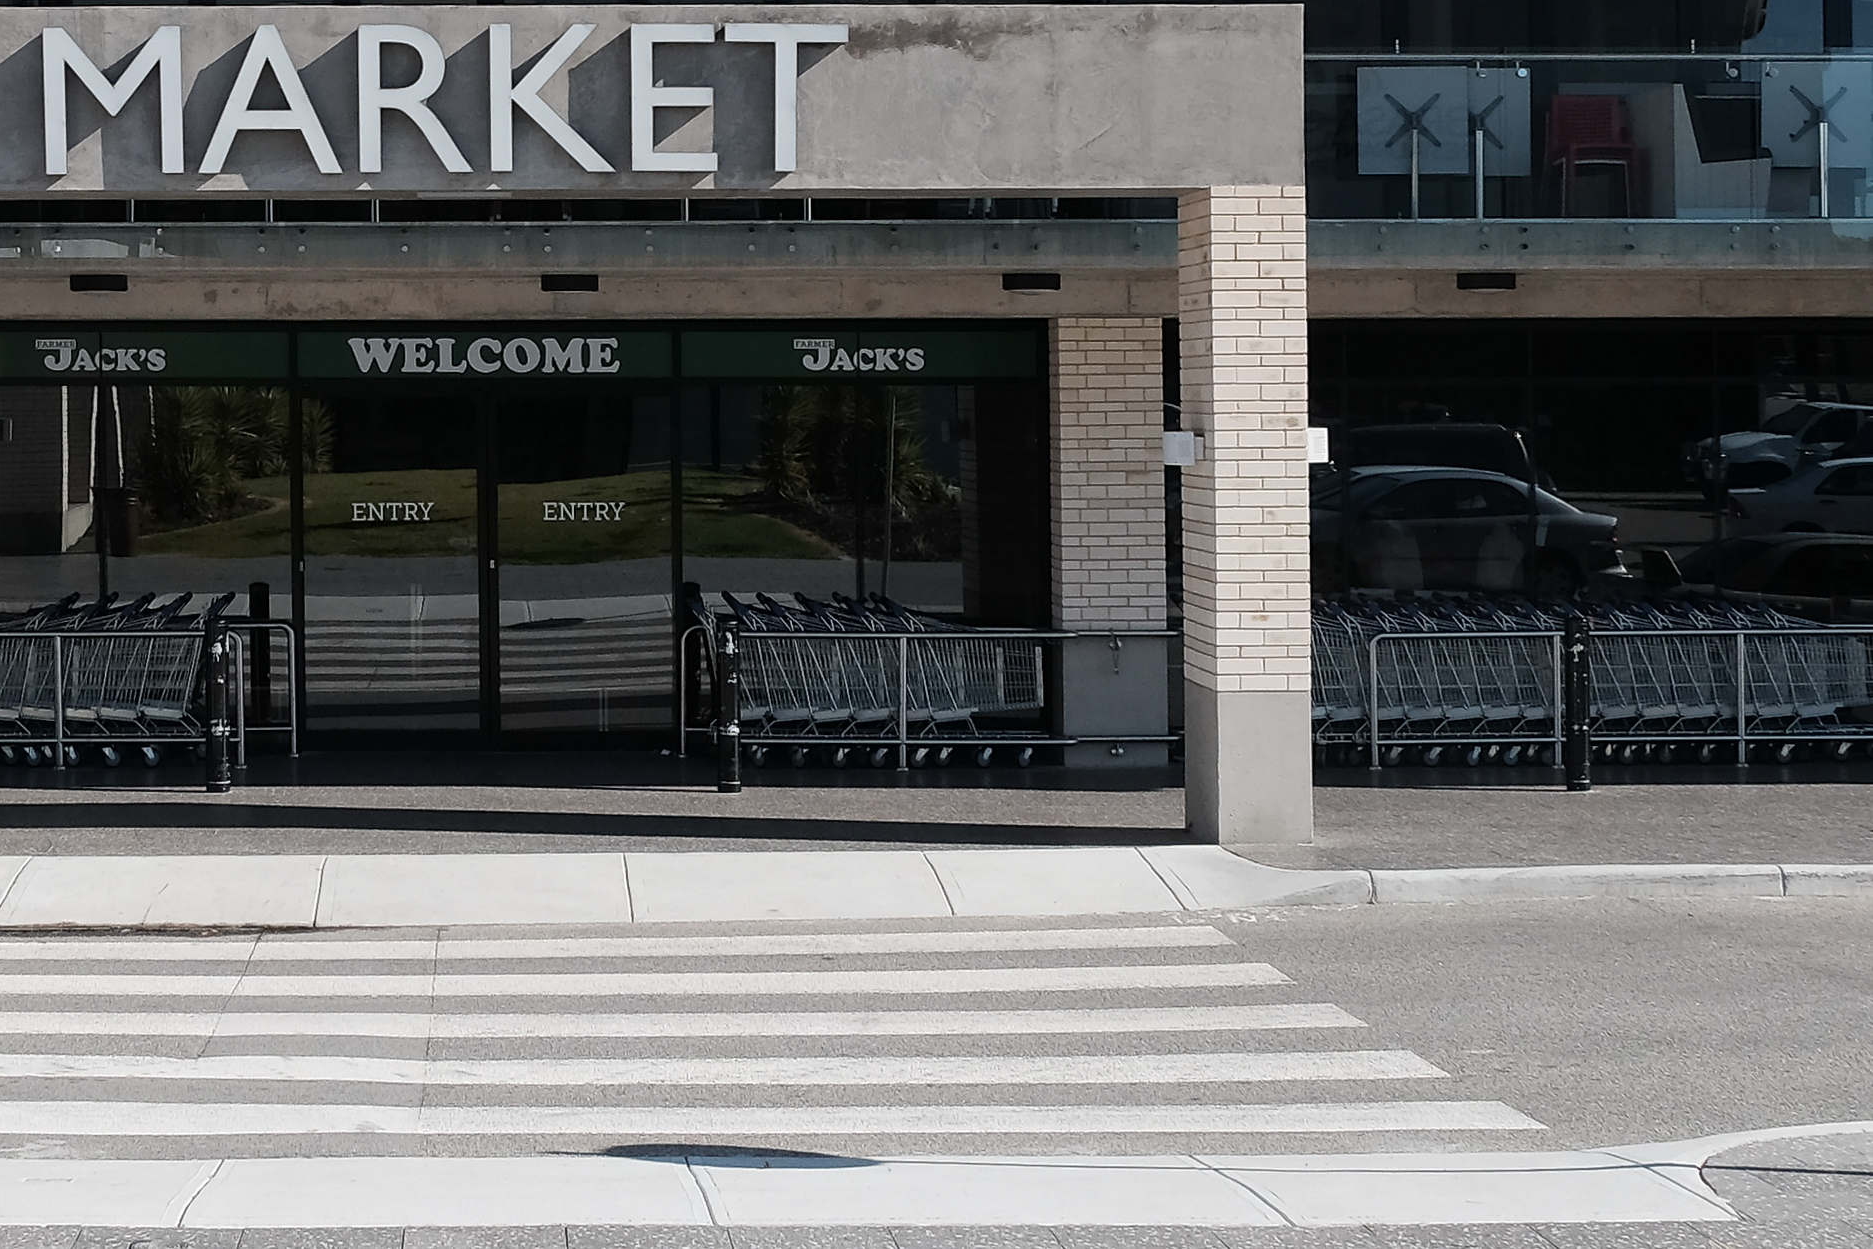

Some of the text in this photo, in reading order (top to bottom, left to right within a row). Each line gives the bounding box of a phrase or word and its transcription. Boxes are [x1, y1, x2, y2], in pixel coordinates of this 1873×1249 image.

[42, 23, 849, 175] MARKET
[36, 340, 76, 349] FARMER
[347, 337, 621, 374] WELCOME
[795, 340, 835, 349] FARMER
[43, 347, 167, 372] JACK'S
[802, 347, 925, 372] JACK'S
[351, 502, 434, 522] ENTRY
[542, 502, 625, 521] ENTRY
